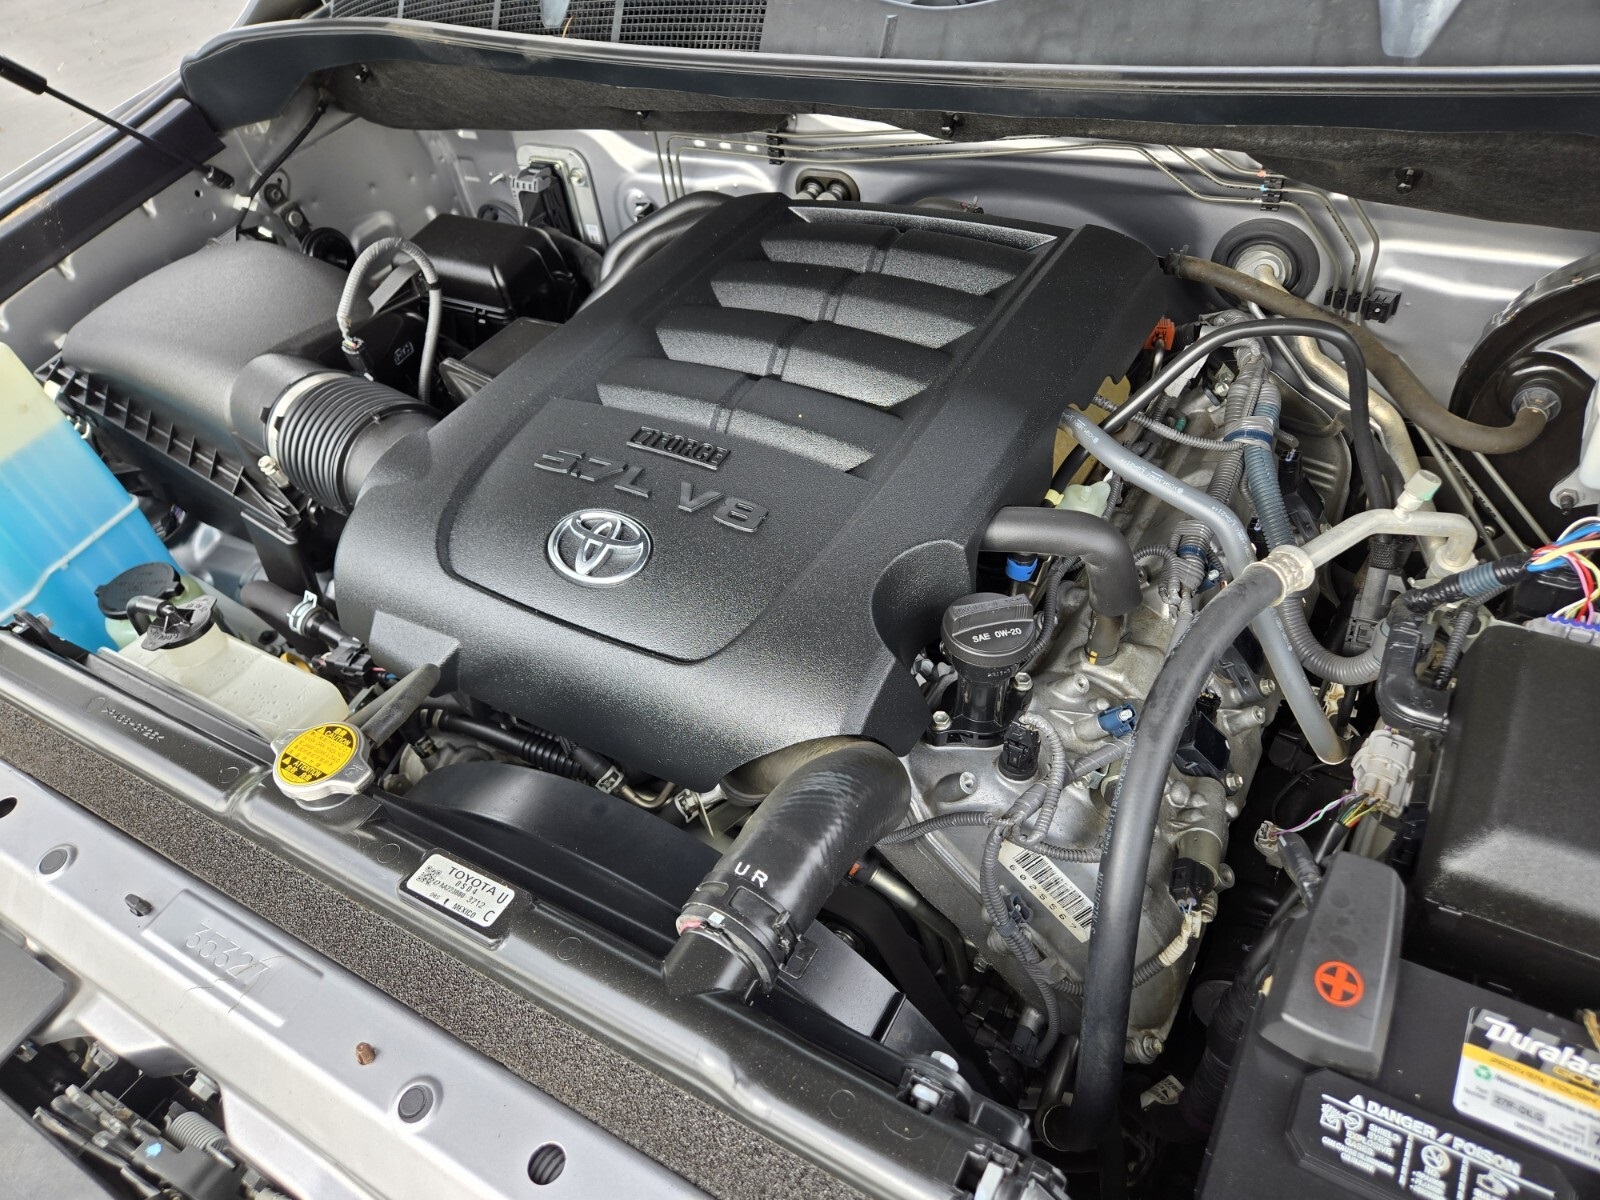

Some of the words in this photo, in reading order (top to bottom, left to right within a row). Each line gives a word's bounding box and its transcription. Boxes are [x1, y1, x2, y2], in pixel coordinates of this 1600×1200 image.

[678, 480, 769, 533] V8
[972, 632, 991, 643] SAE
[994, 627, 1022, 639] 0W-20
[324, 730, 352, 746] CAUTION
[292, 760, 323, 778] ATTENTION
[448, 866, 497, 896] TOYOTA
[452, 903, 477, 919] MEXICO
[483, 910, 496, 922] C
[1366, 1099, 1439, 1140] DANGER
[1452, 1132, 1522, 1177] POISON
[1368, 1123, 1402, 1144] SHIELD
[1345, 1129, 1396, 1159] EXPLOSIVE
